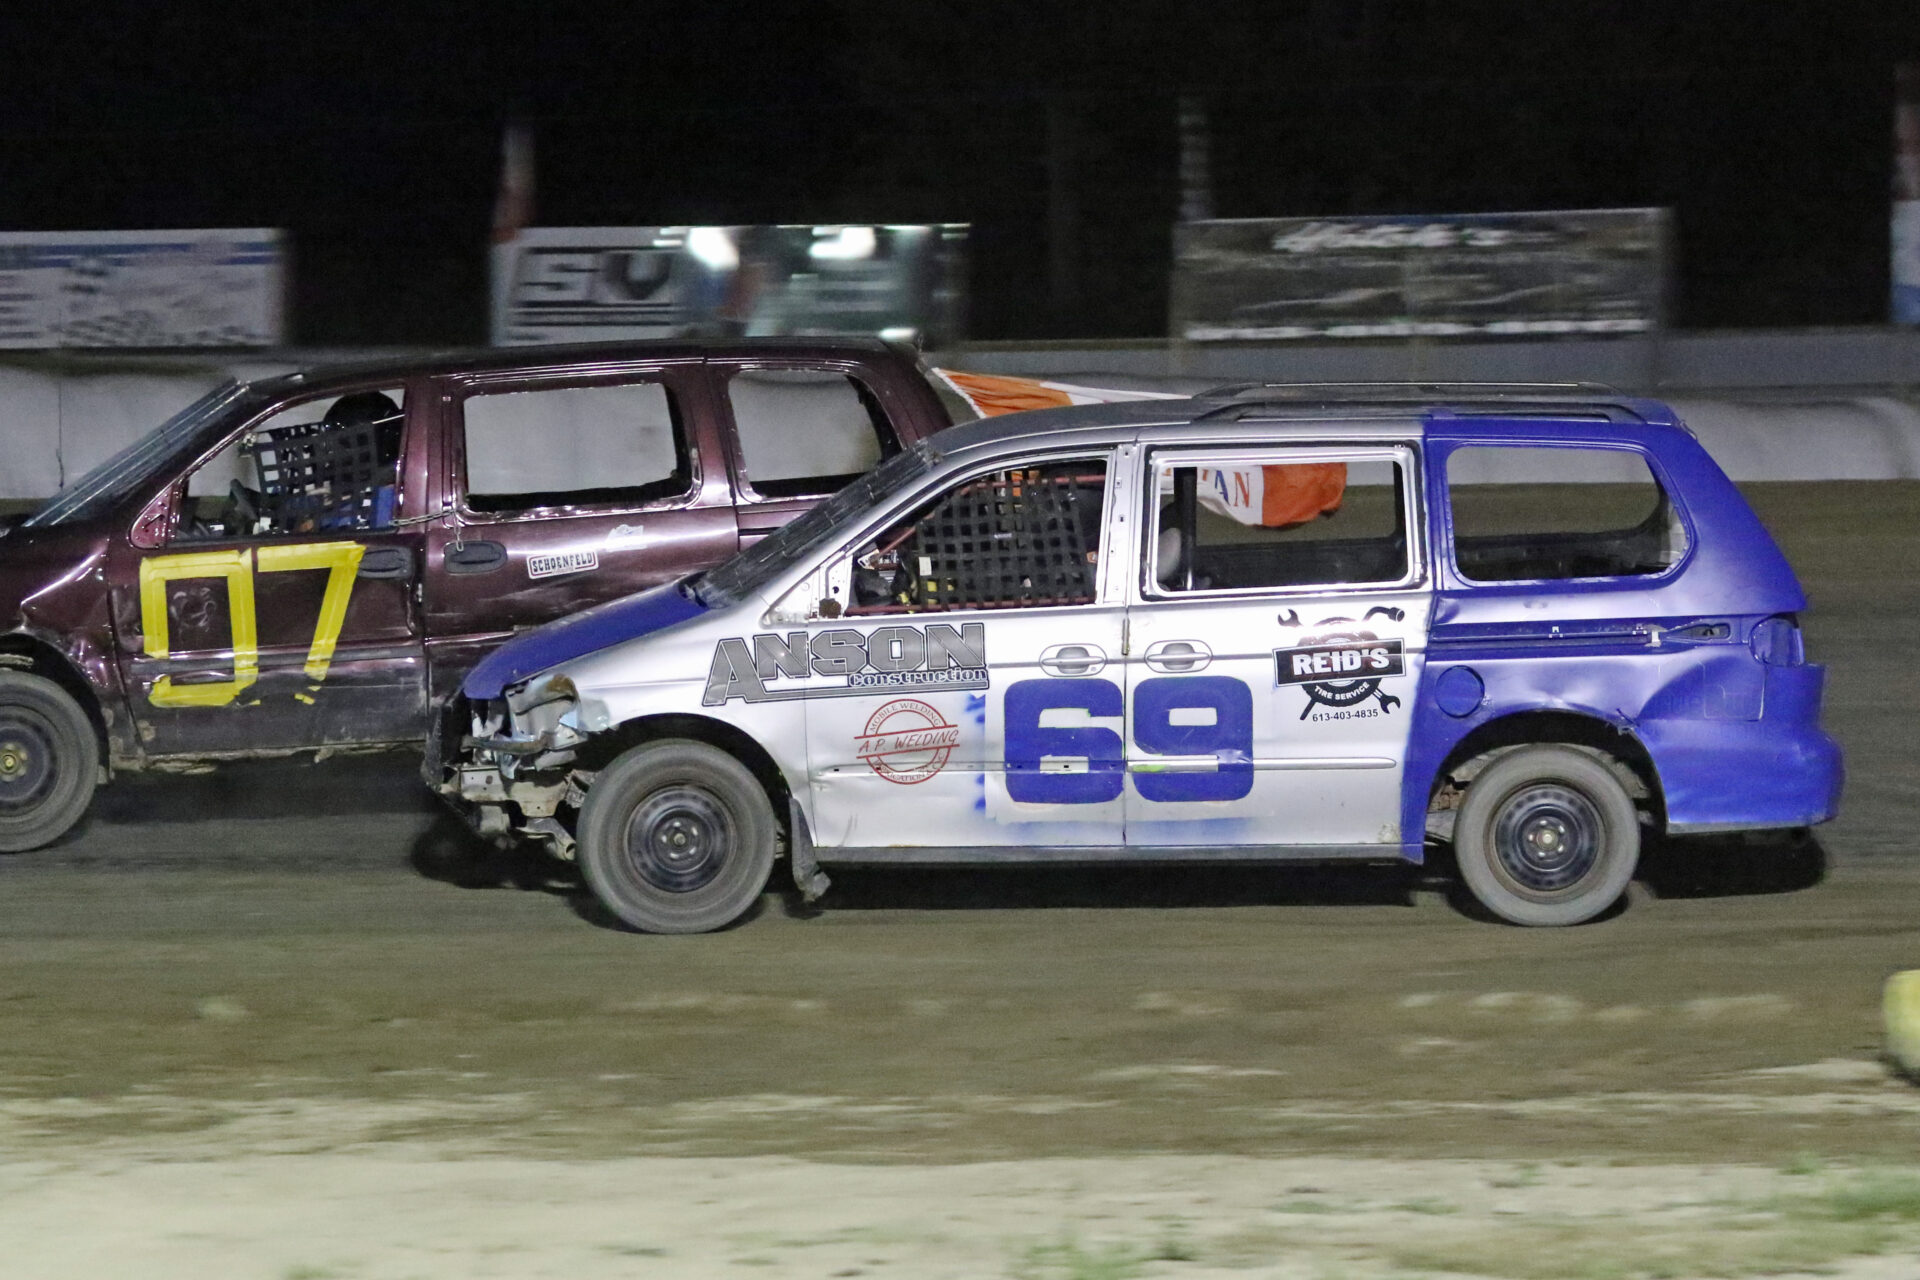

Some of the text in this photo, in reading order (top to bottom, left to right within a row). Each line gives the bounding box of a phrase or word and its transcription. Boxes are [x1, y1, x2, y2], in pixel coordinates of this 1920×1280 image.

[532, 552, 594, 573] SCHOENFELD
[140, 541, 366, 708] 07
[702, 622, 988, 707] ANSON
[1292, 648, 1390, 676] REID'S
[849, 667, 988, 688] Construction
[1314, 681, 1371, 700] TIRE SERVICE
[869, 702, 942, 732] MOBILE WELDING
[1312, 708, 1379, 722] 613-403-4835
[894, 729, 959, 750] WELDING
[1004, 675, 1253, 804] 69
